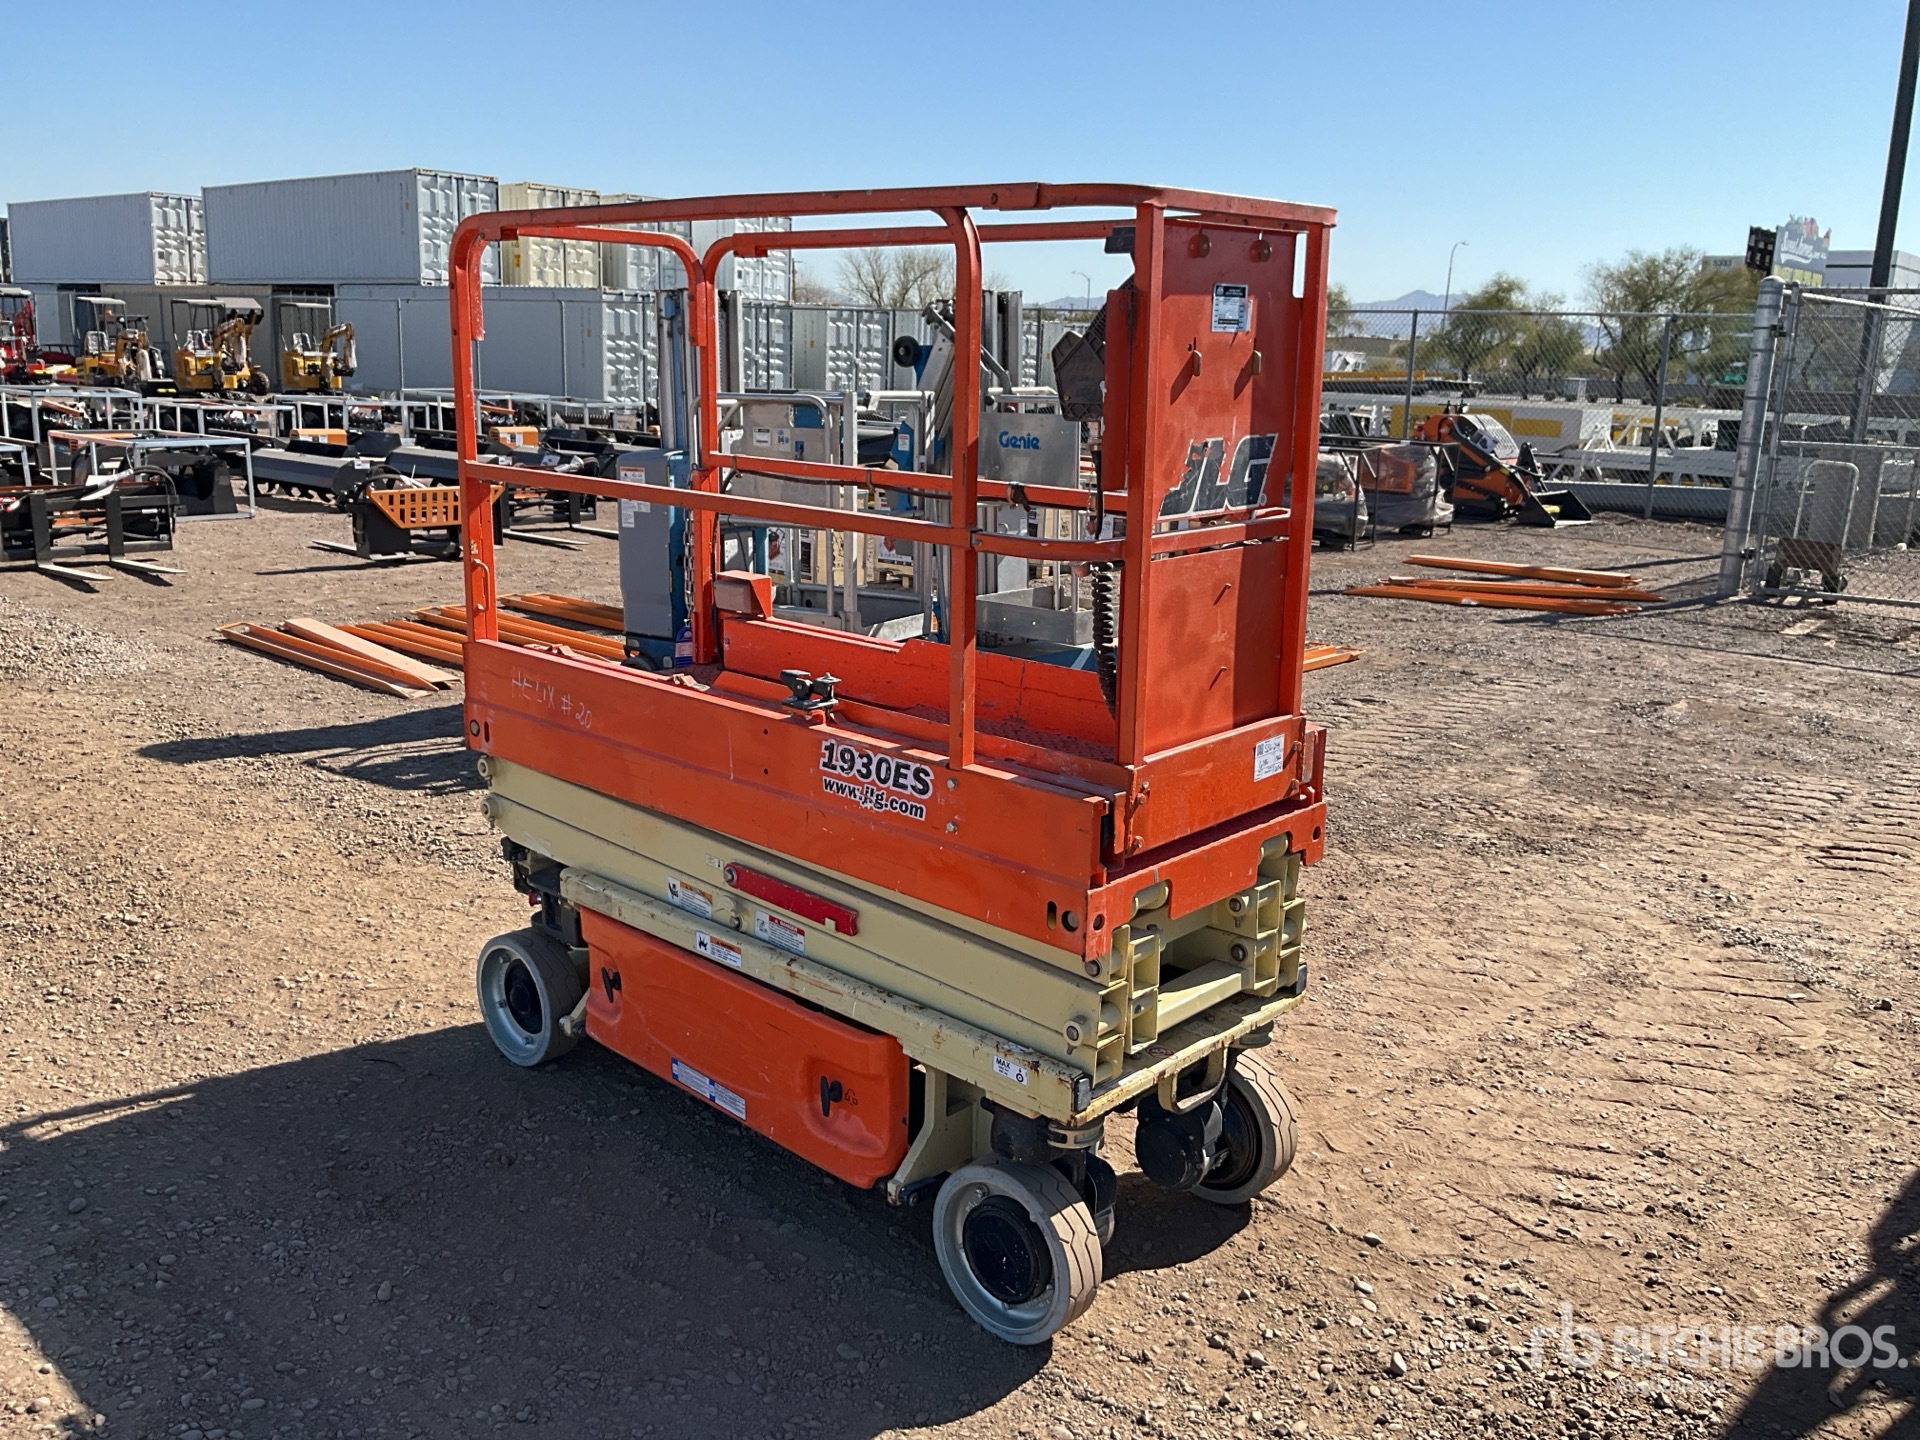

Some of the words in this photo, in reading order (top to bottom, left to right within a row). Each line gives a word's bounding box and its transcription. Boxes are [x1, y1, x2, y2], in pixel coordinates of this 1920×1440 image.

[998, 430, 1041, 450] Genie
[1157, 433, 1278, 520] JLG
[820, 740, 933, 798] 1930ES
[823, 777, 926, 820] www.jlg.com
[995, 1057, 1011, 1069] MAX
